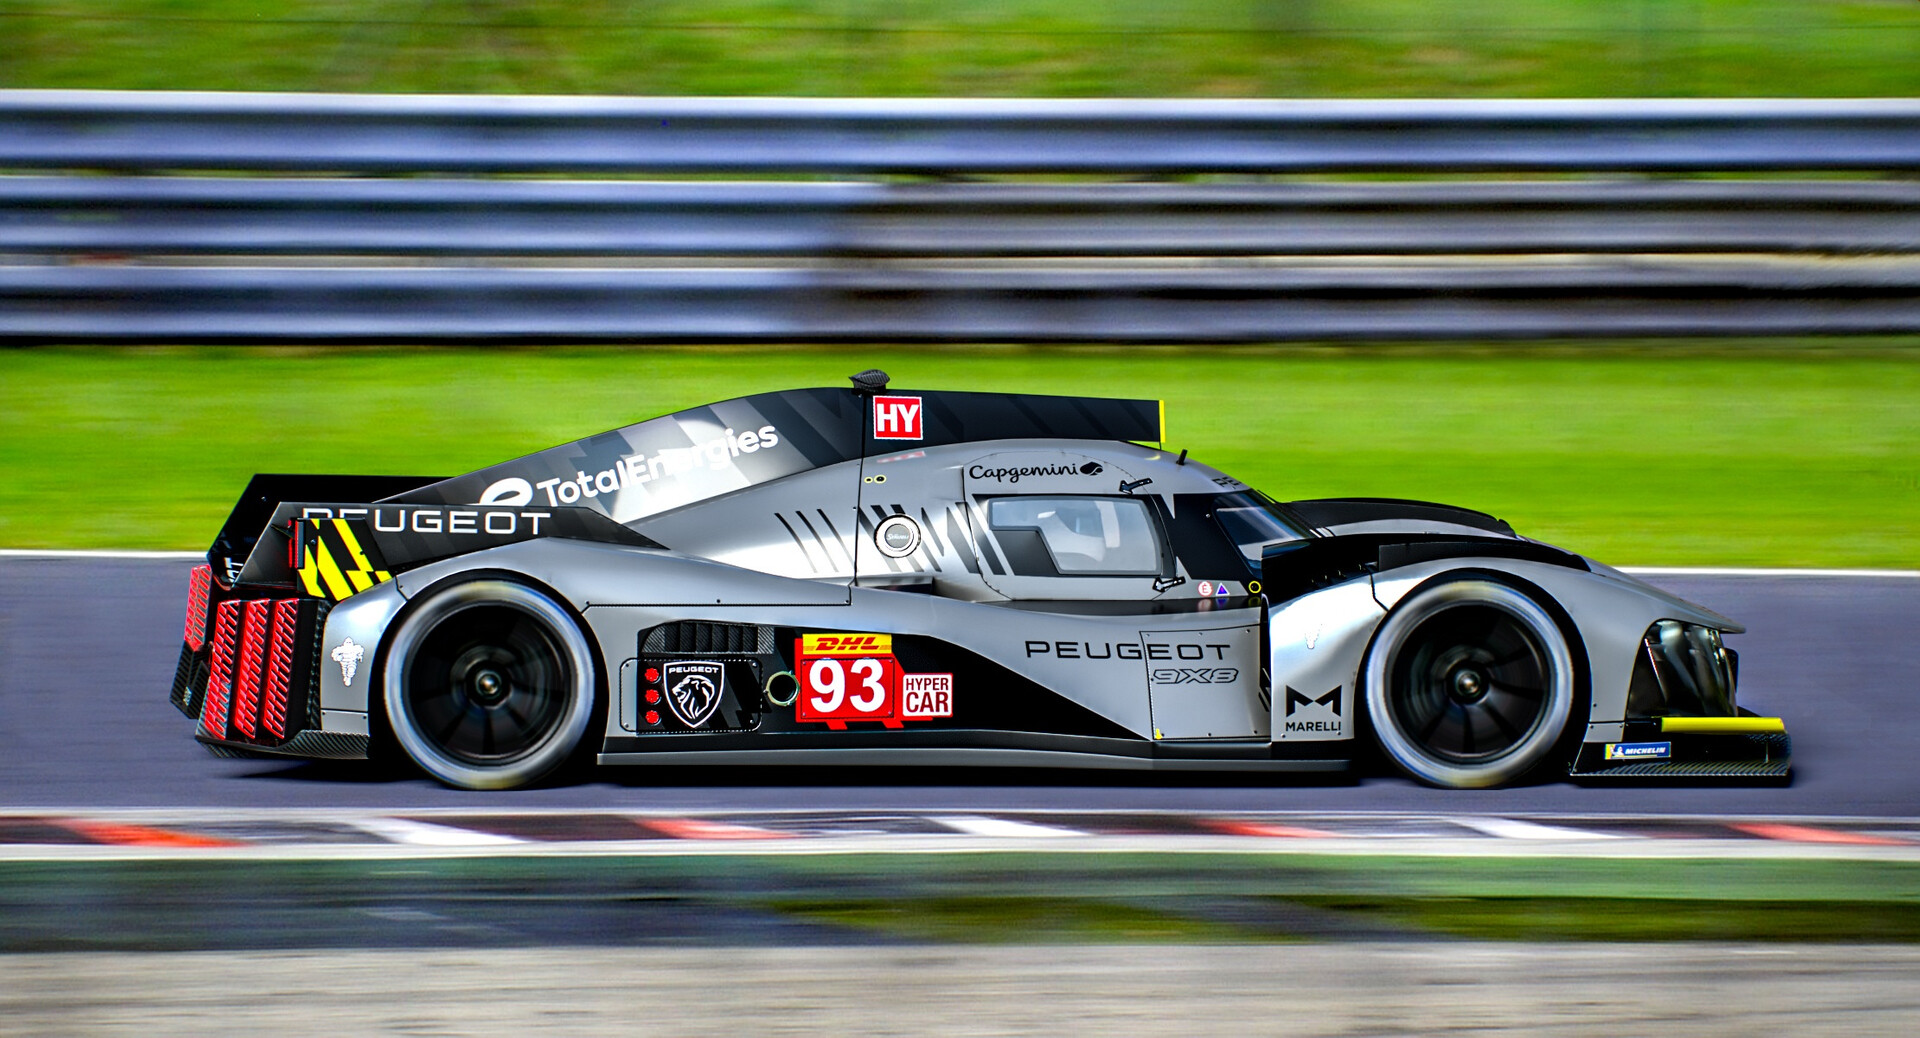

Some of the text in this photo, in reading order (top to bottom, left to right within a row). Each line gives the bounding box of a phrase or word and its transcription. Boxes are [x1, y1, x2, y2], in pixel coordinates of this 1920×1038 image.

[876, 403, 920, 433] HY
[536, 425, 779, 507] TotalEnergies
[969, 462, 1079, 484] Capgemini
[815, 637, 880, 650] DHL
[1024, 640, 1231, 661] PEUGEOT
[668, 667, 719, 675] PEUGEOT
[1152, 667, 1240, 685] 9X8
[808, 658, 887, 714] 93
[905, 677, 949, 691] HYPER
[905, 691, 949, 714] CAR
[1285, 721, 1342, 732] MARELLI
[1625, 747, 1666, 755] MICHELIN
